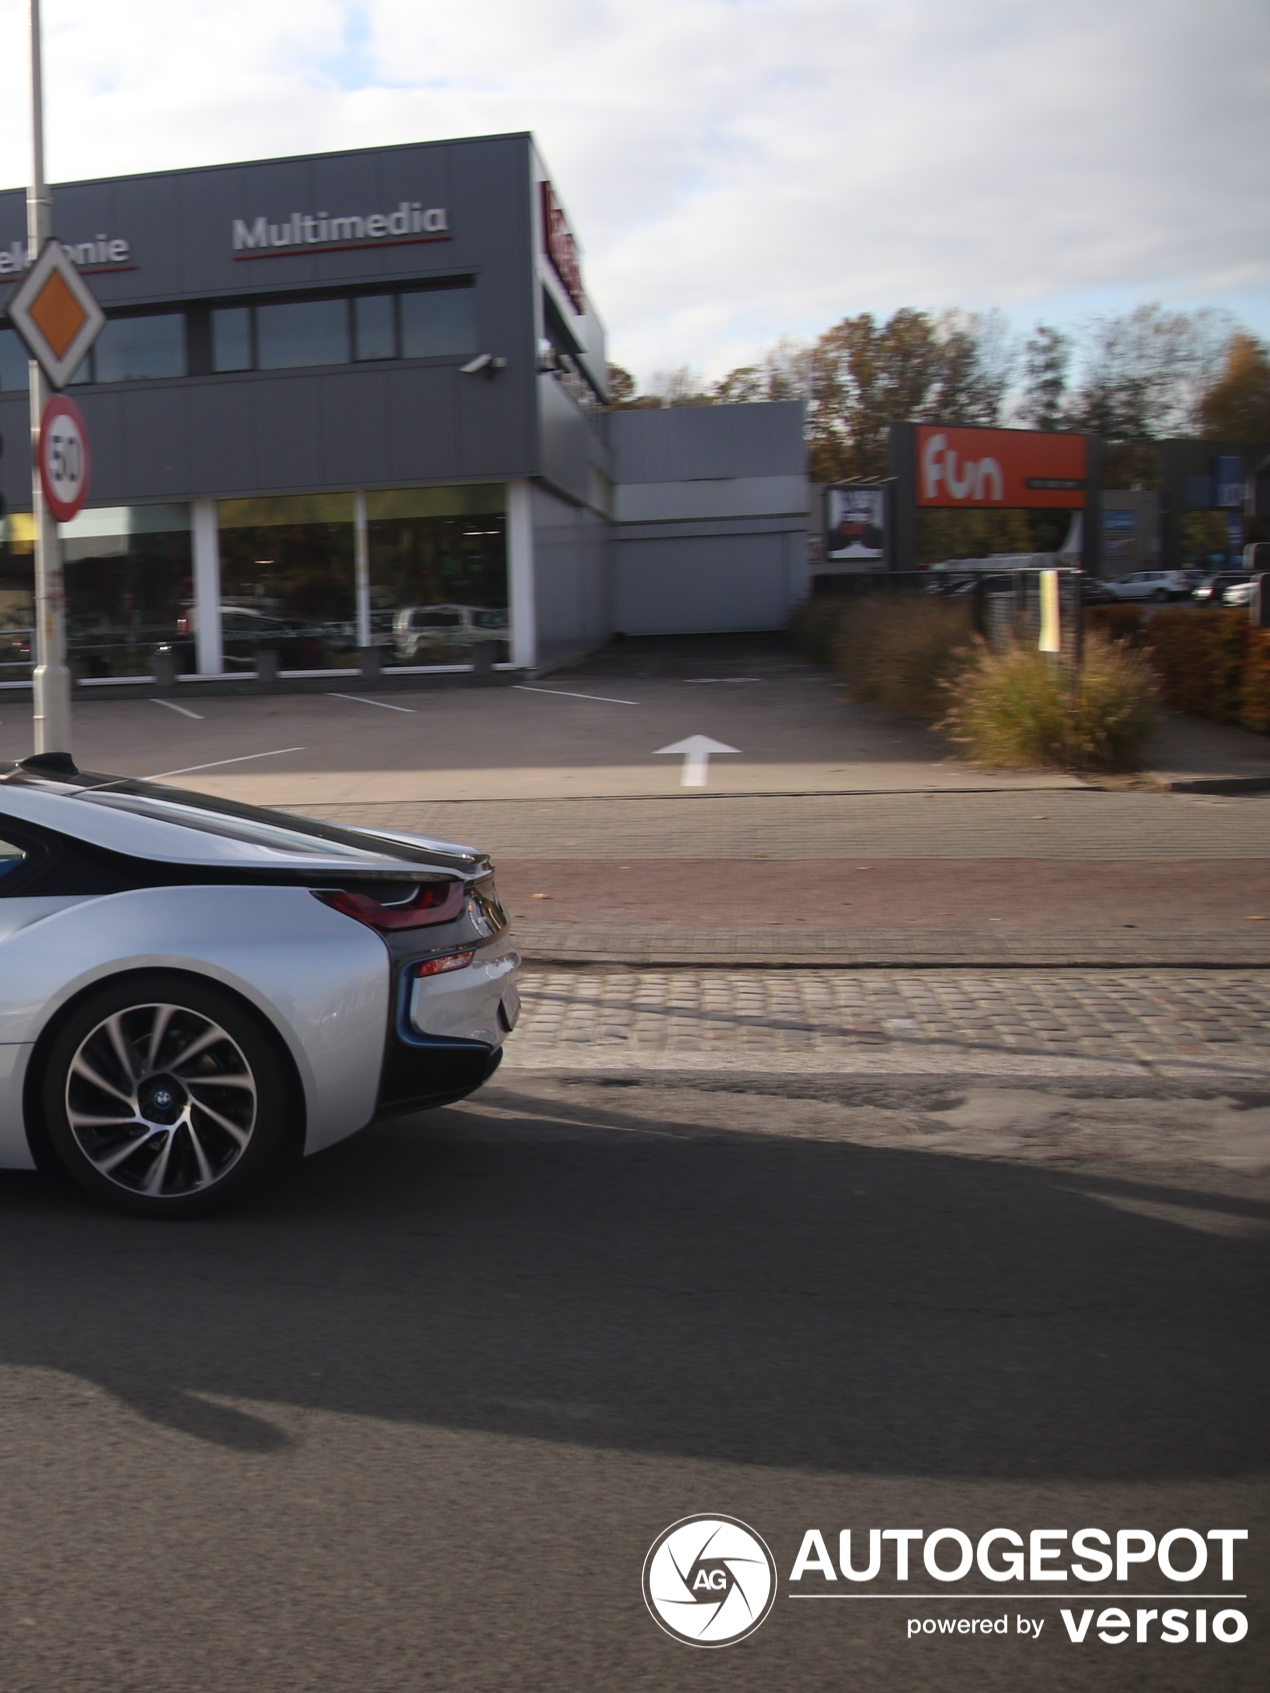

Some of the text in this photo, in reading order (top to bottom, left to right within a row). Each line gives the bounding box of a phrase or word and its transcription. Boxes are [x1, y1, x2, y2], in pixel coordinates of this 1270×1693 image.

[232, 202, 449, 250] Multimedia
[48, 434, 79, 481] 50
[922, 432, 1004, 500] fun
